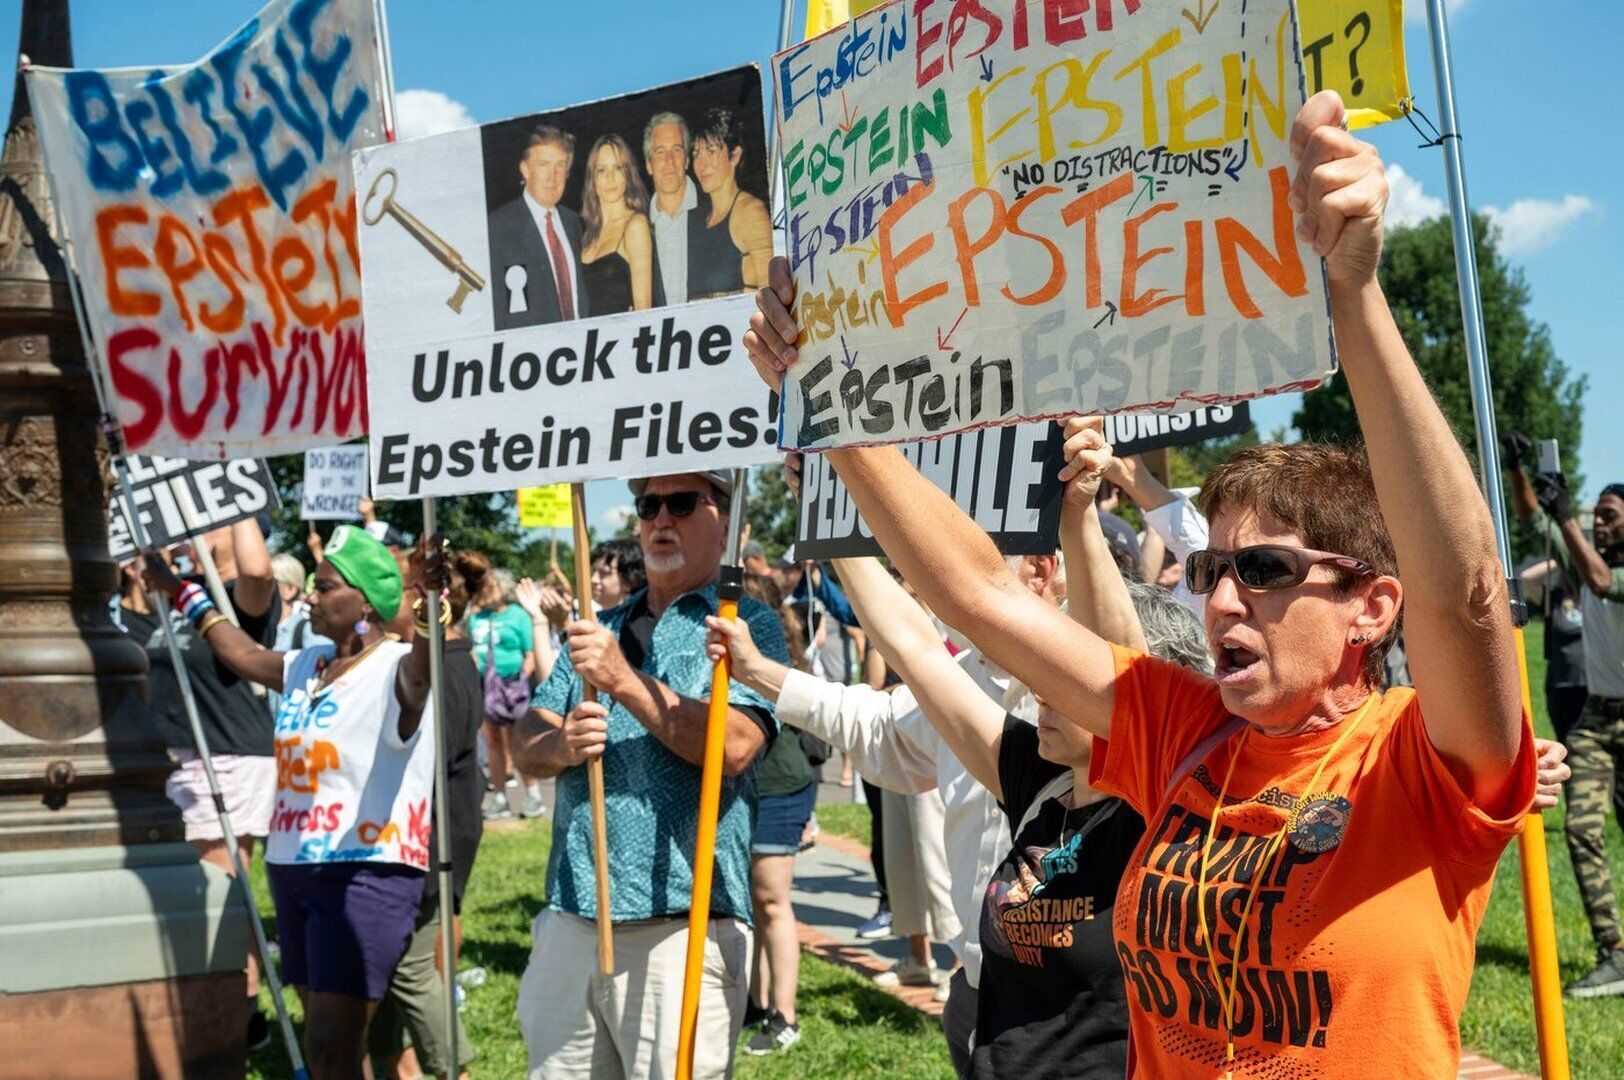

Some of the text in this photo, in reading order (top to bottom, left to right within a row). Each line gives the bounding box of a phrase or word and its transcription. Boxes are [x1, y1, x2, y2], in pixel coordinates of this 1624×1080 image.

[783, 87, 952, 211] EPSTEIN
[966, 9, 1291, 188] EPSTEIN
[878, 166, 1308, 328] EPSTEIN
[412, 317, 732, 402] Unlock the
[1022, 309, 1318, 414] EPSTEIN
[377, 389, 779, 494] Epstein Files!
[117, 458, 267, 549] FILES
[1136, 872, 1286, 966] MUST
[1117, 940, 1333, 1049] GO NOW!
